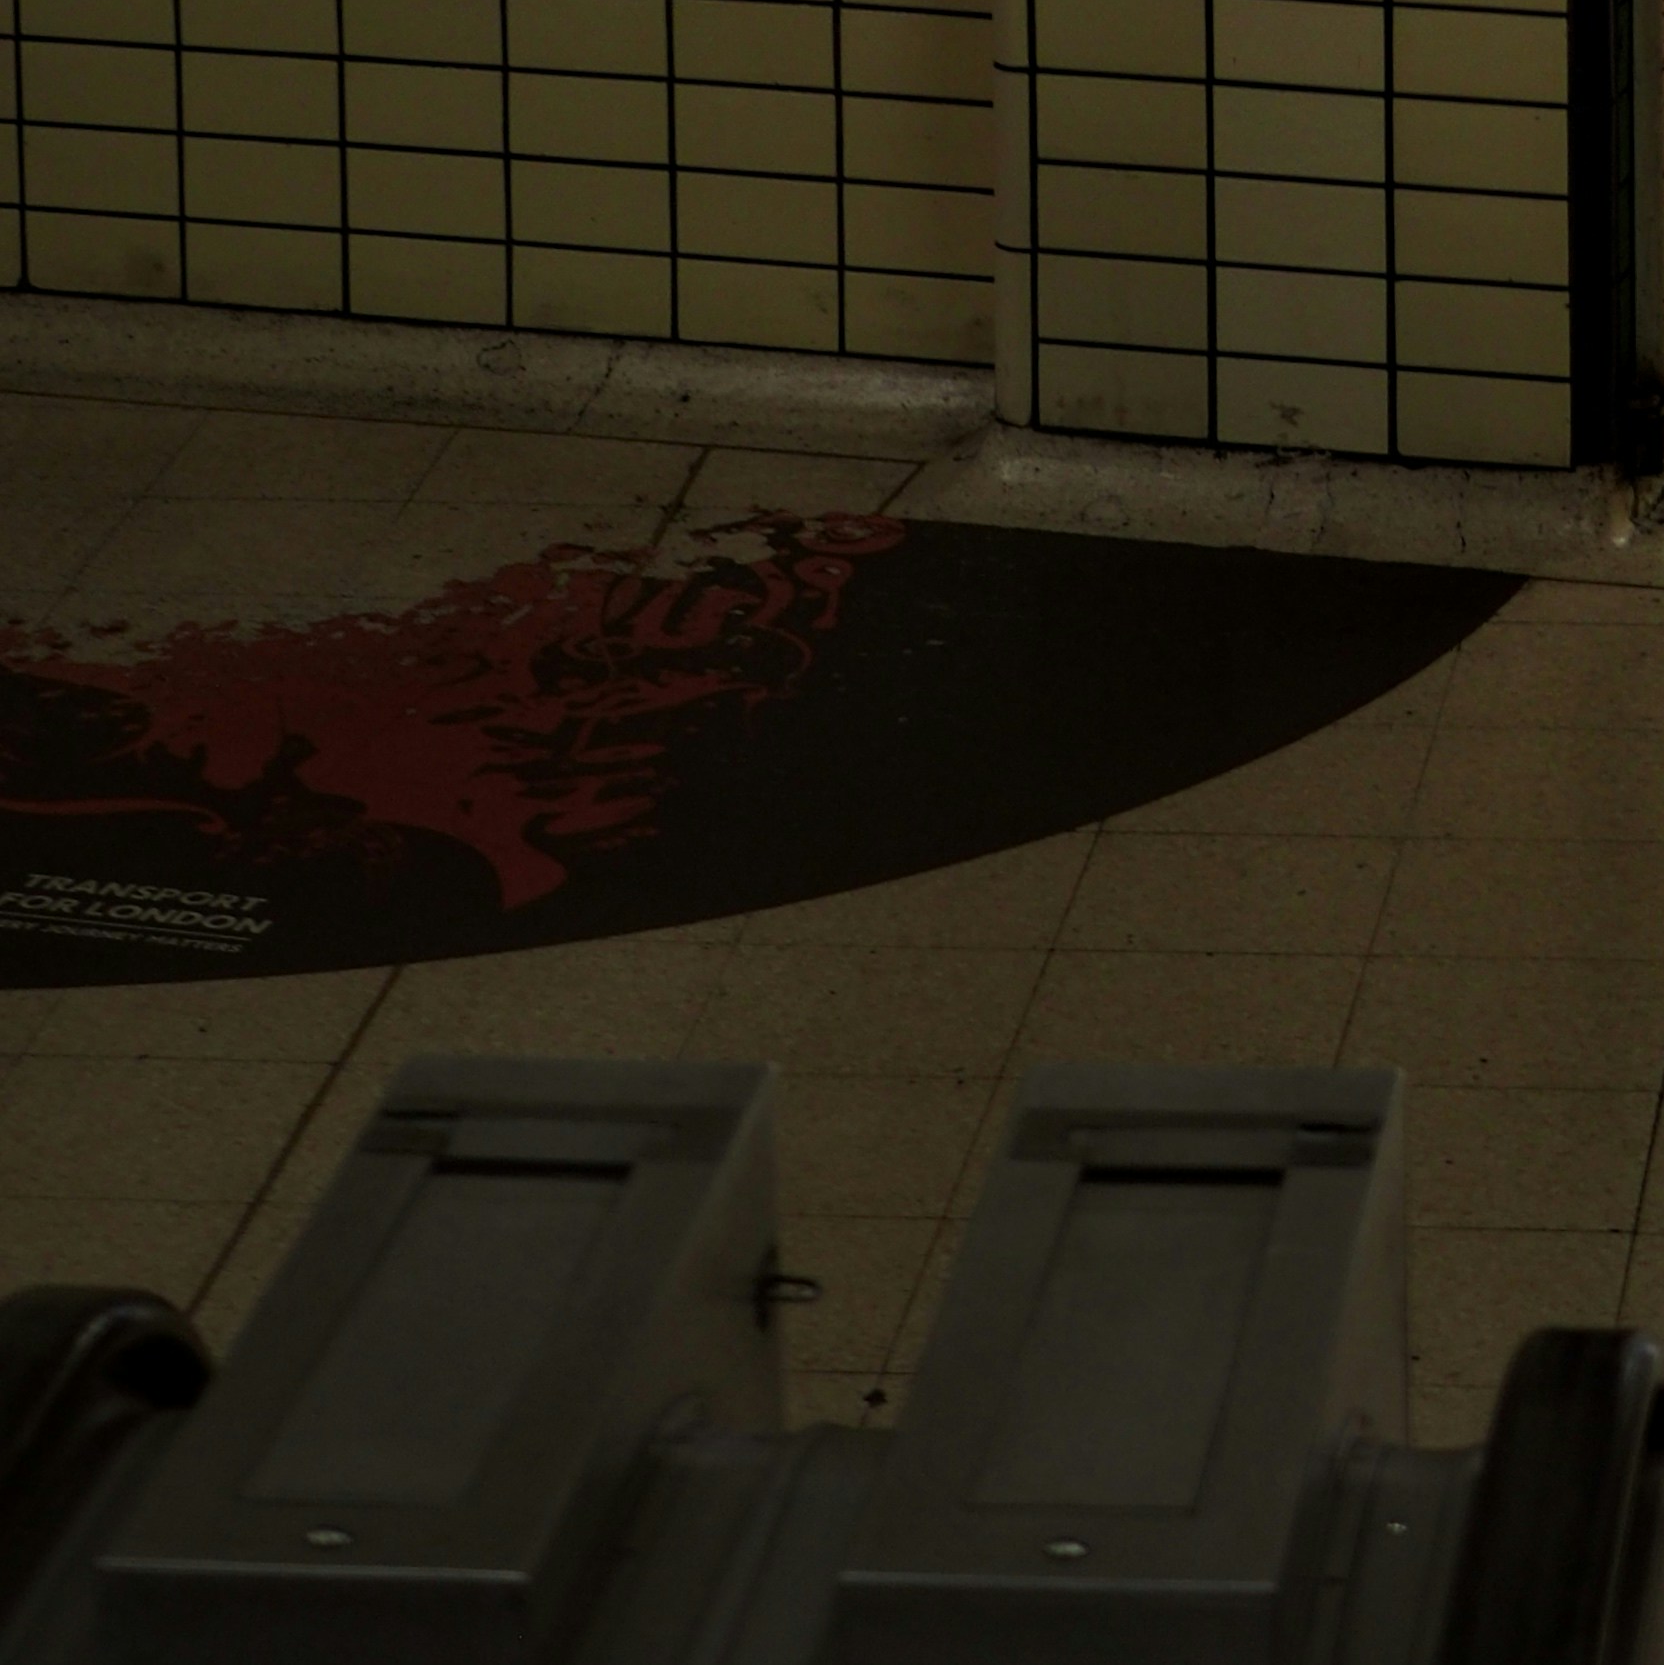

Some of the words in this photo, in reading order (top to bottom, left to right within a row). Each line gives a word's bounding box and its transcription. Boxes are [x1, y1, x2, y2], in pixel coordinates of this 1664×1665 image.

[23, 872, 269, 912] TRANSPORT
[0, 891, 80, 914] FOR
[84, 900, 273, 935] LONDON
[144, 934, 245, 953] MATTERS
